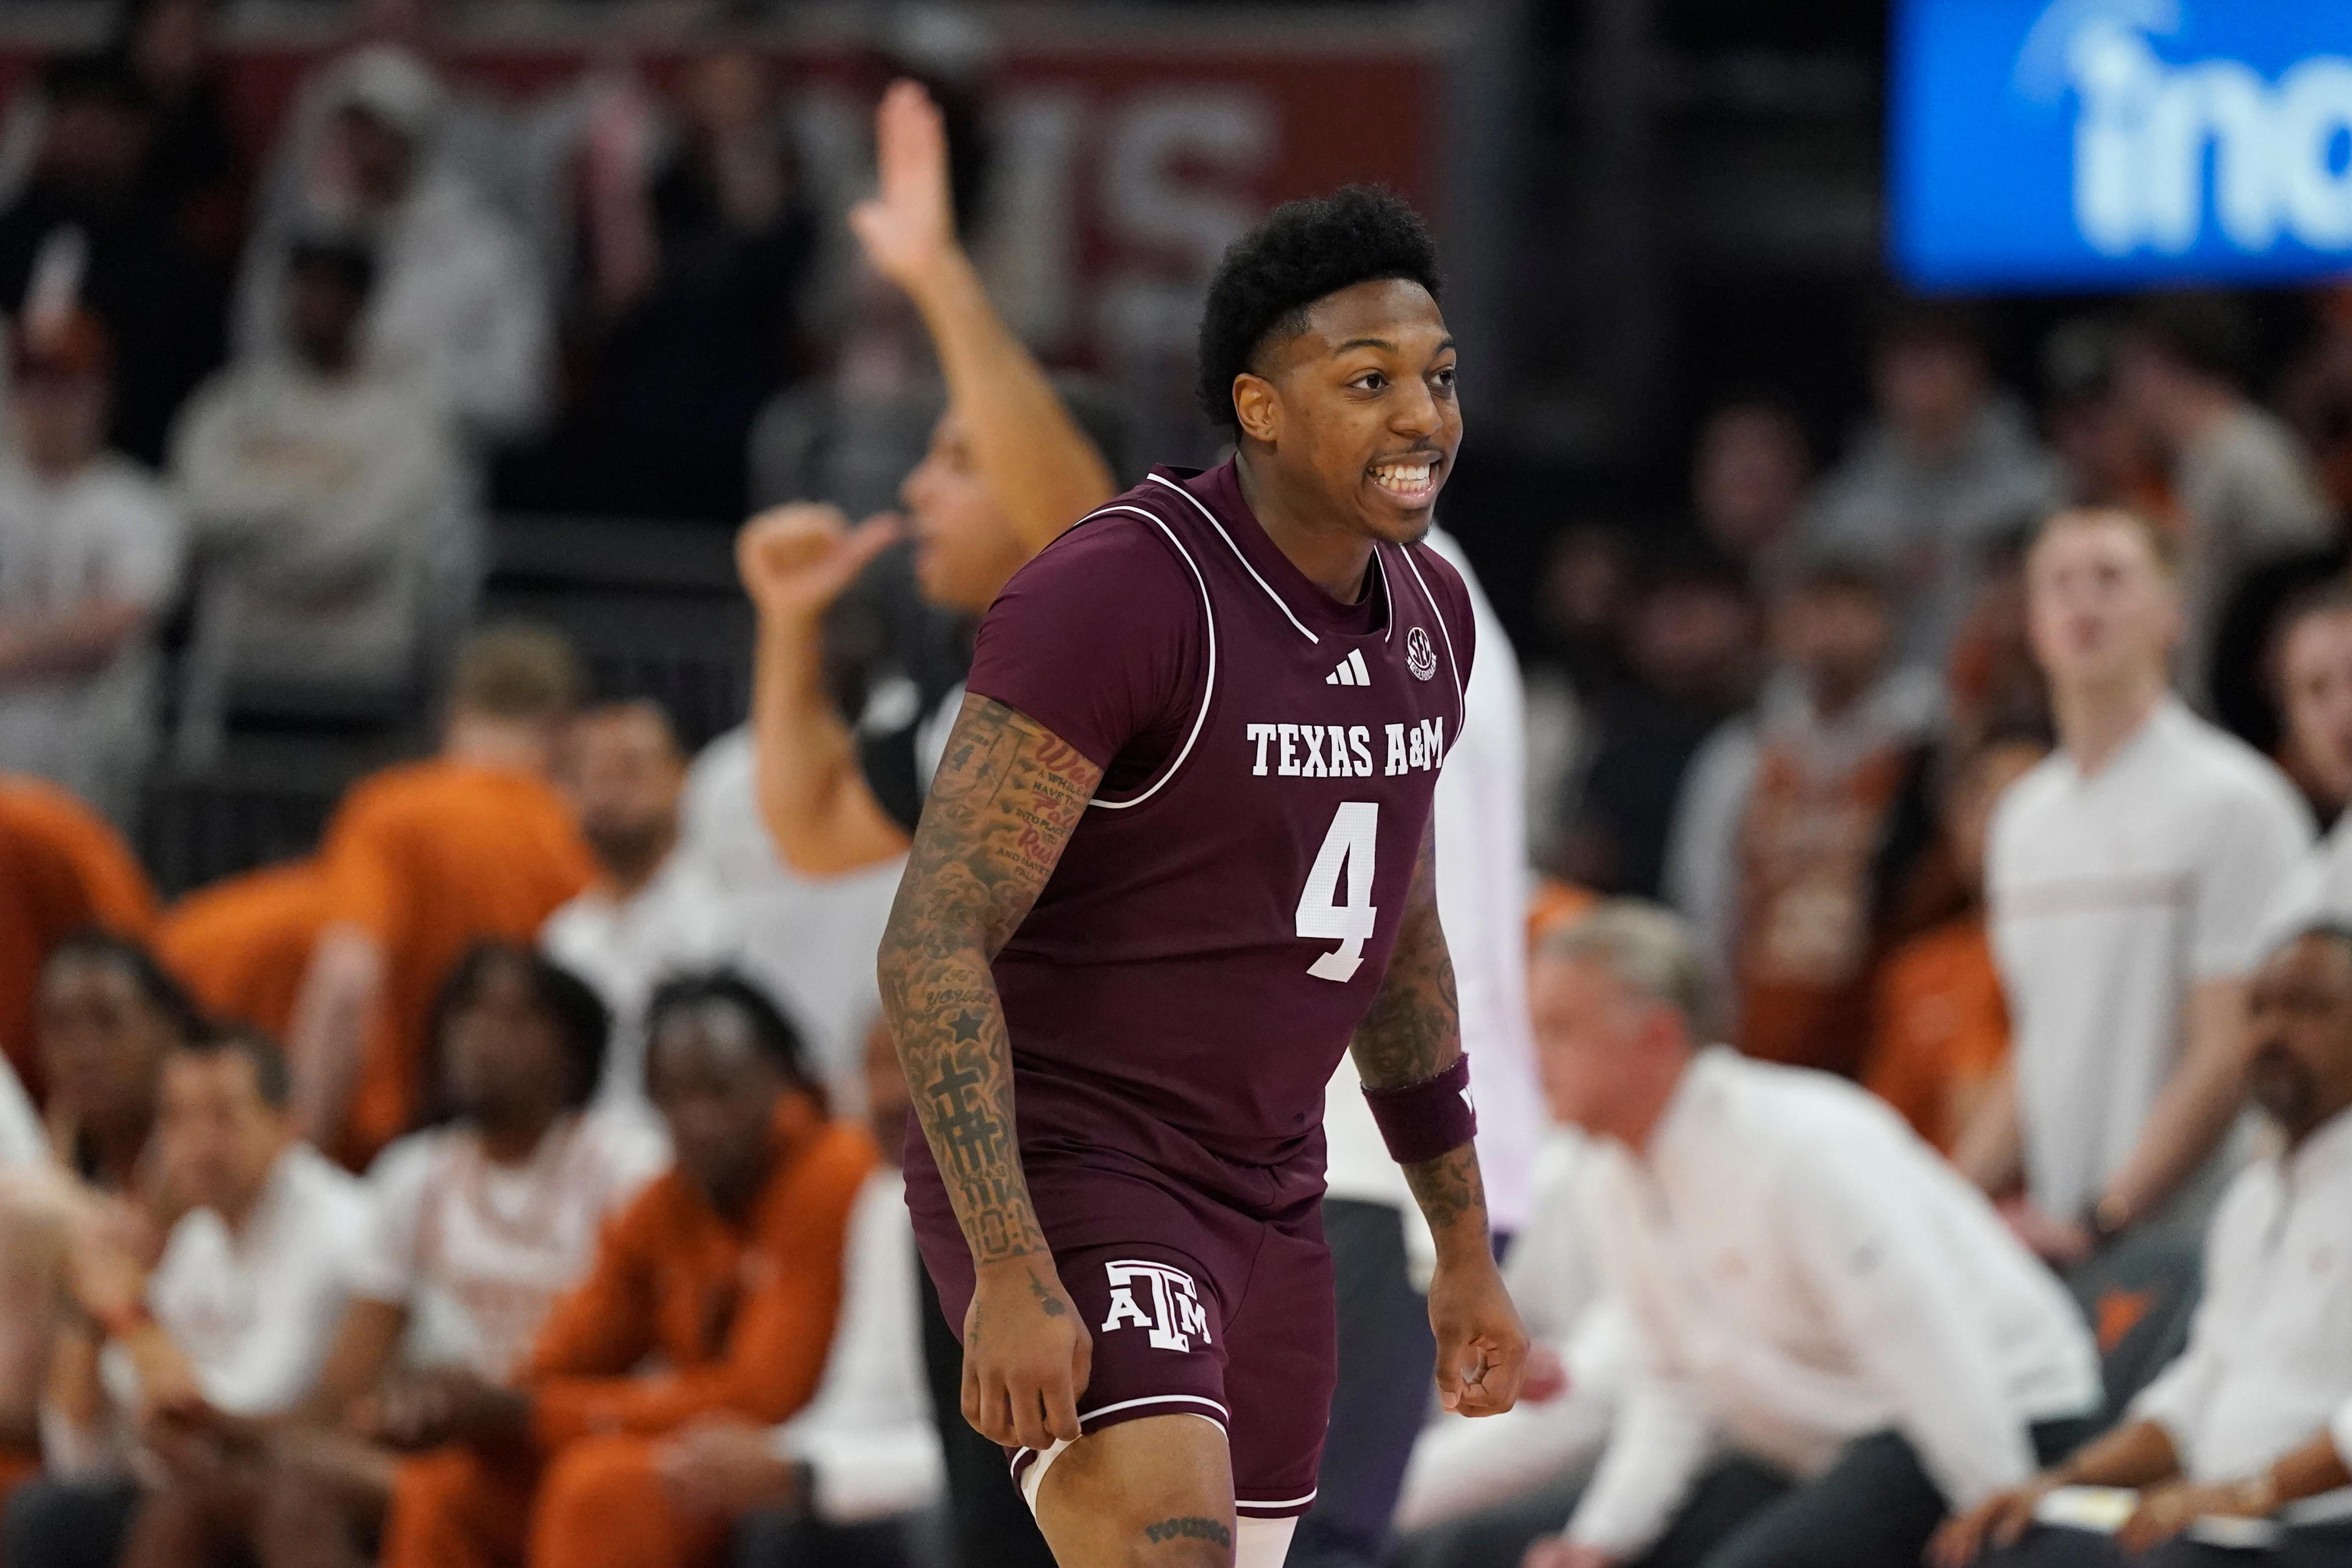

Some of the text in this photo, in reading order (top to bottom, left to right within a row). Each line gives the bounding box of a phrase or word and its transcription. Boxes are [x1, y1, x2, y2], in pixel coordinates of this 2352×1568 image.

[1409, 628, 1431, 667] SEC
[1247, 716, 1443, 778] TEXAS A&M
[1295, 801, 1380, 983] 4
